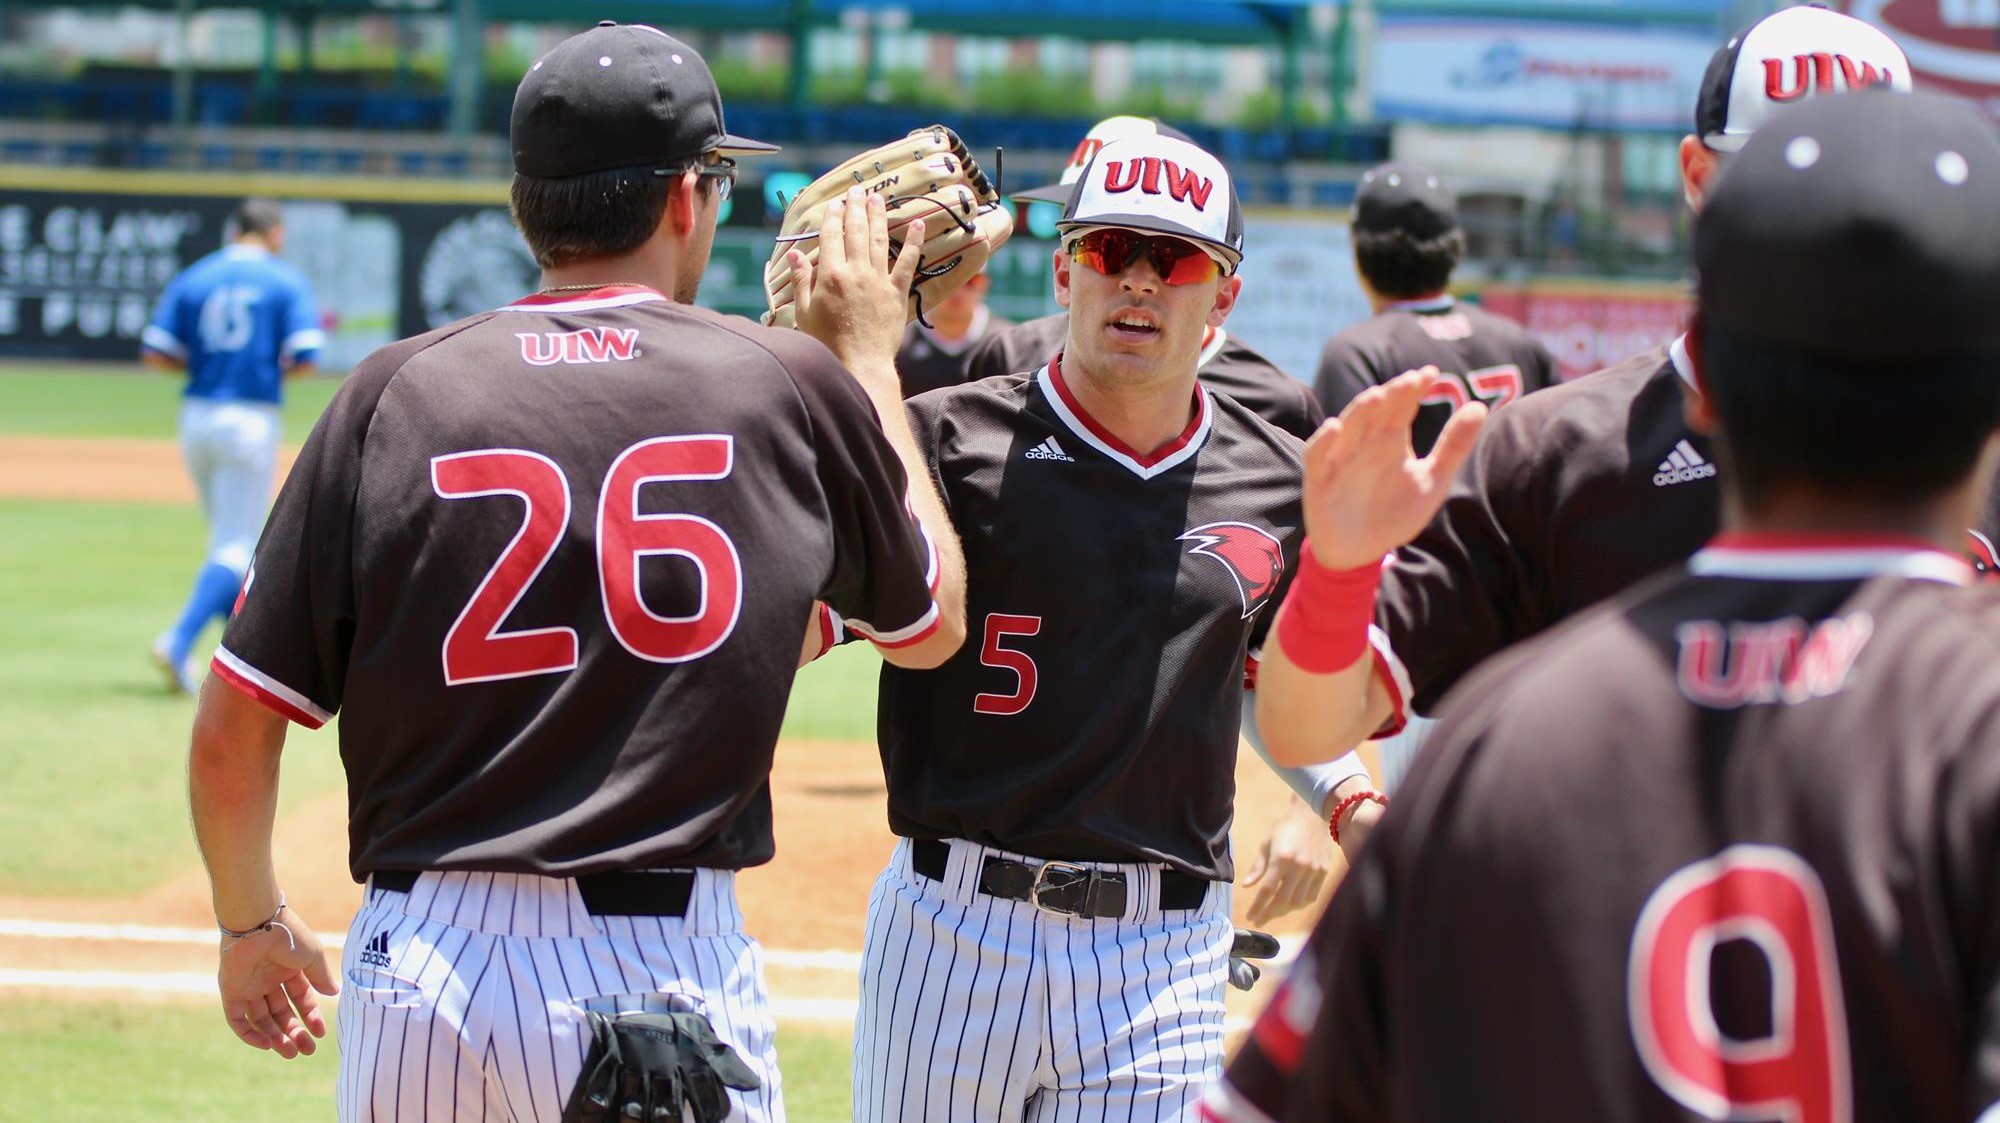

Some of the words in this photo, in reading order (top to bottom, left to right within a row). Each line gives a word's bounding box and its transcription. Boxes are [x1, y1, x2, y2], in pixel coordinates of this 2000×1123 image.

[1761, 51, 1892, 101] UIW
[1104, 157, 1213, 212] UIW
[42, 291, 150, 339] PUR
[514, 326, 639, 366] UIW
[1025, 451, 1075, 462] adidas
[1653, 462, 1716, 486] adidas
[430, 434, 742, 686] 26
[973, 612, 1042, 715] 5
[360, 951, 392, 968] adidas
[1629, 843, 1853, 1123] 9
